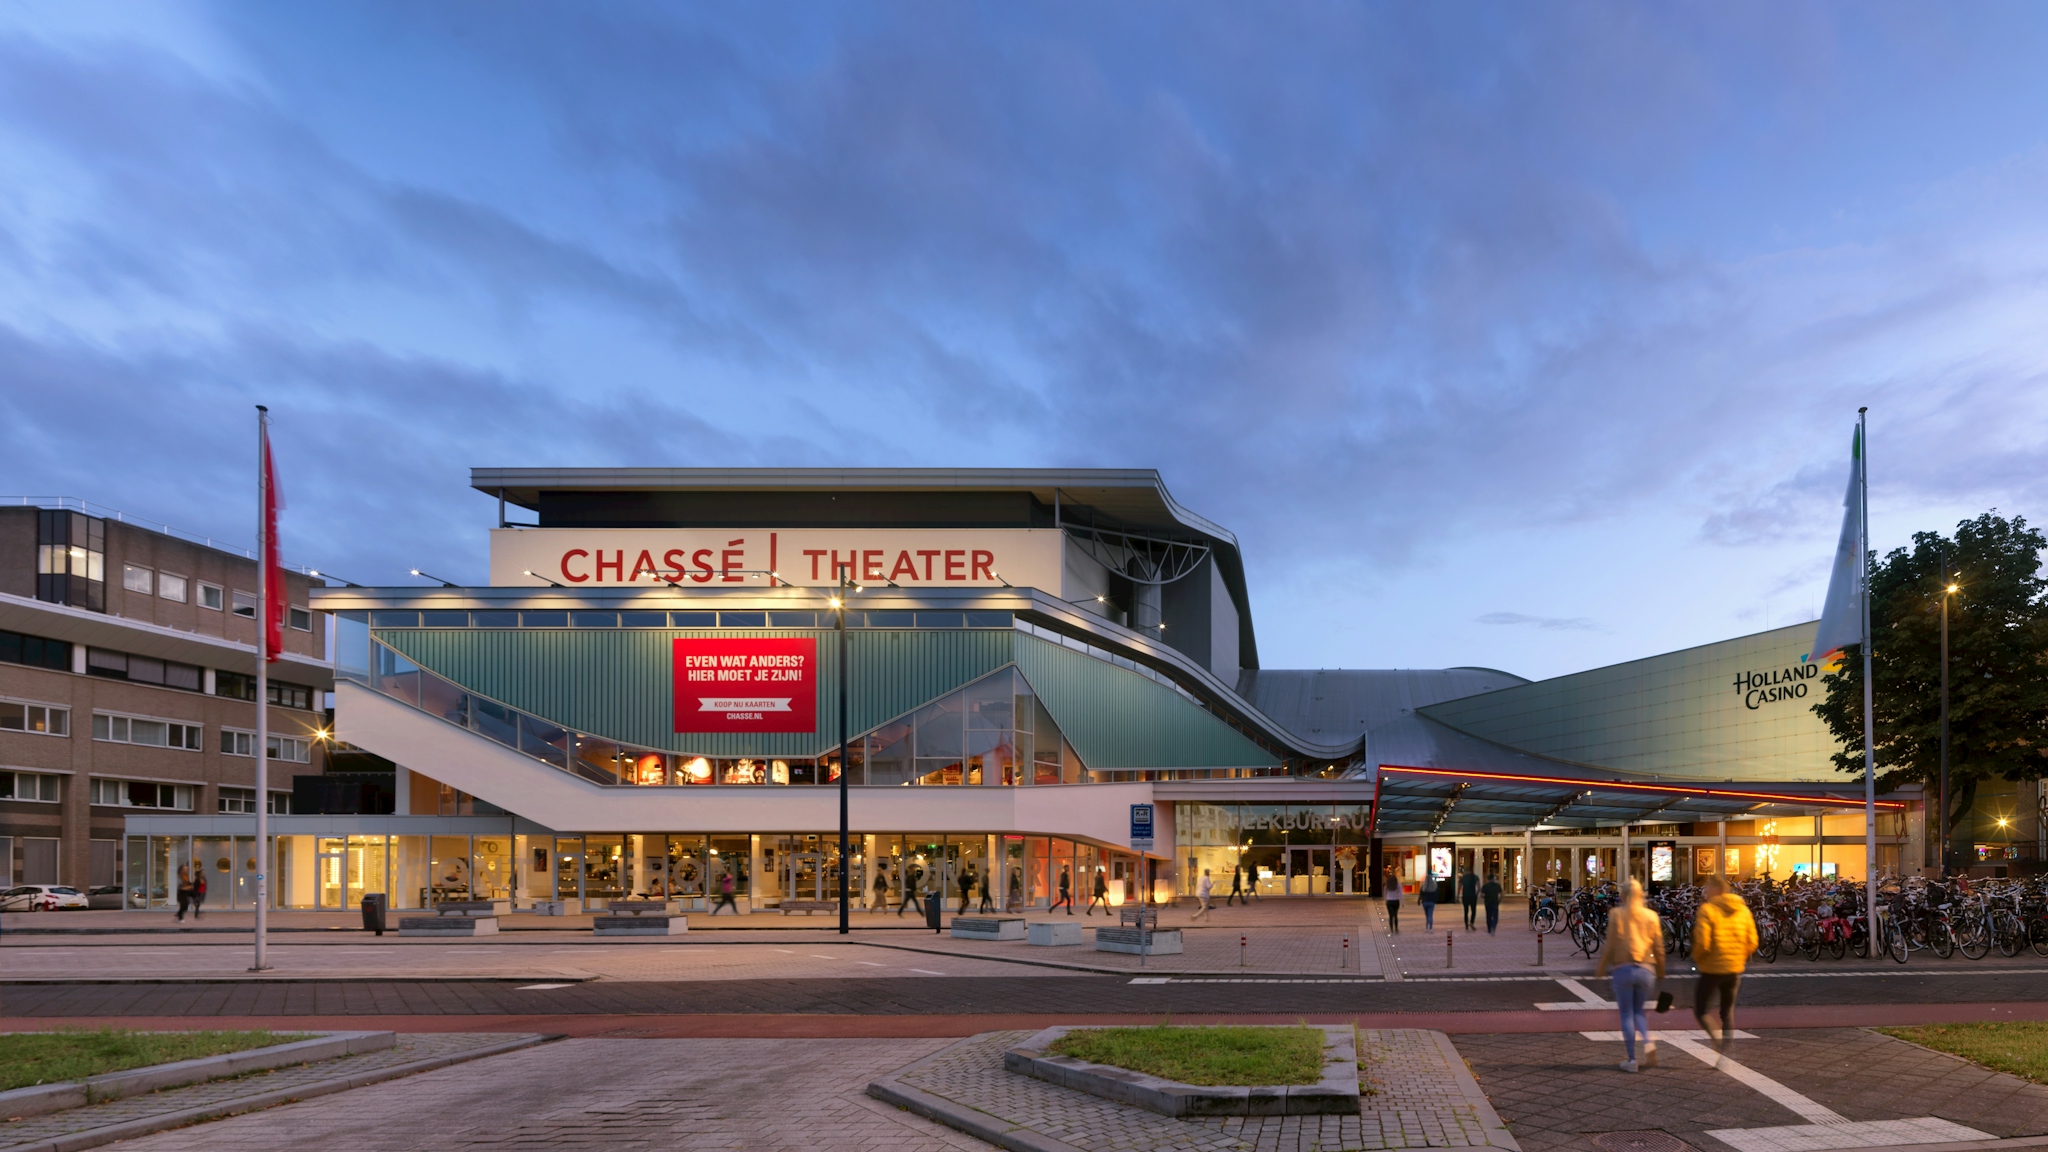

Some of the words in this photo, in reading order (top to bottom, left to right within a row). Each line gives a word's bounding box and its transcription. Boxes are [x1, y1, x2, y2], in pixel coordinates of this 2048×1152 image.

[560, 538, 745, 583] CHASSÉ
[802, 549, 995, 581] THEATER
[685, 655, 717, 667] EVEN
[720, 655, 747, 667] WAT
[749, 655, 805, 667] ANDERS?
[688, 670, 715, 681] HIER
[717, 670, 752, 681] MOET
[754, 670, 769, 681] JE
[771, 670, 802, 681] ZIJN!
[1733, 663, 1818, 695] HOLLAND
[1745, 683, 1808, 710] CASINO
